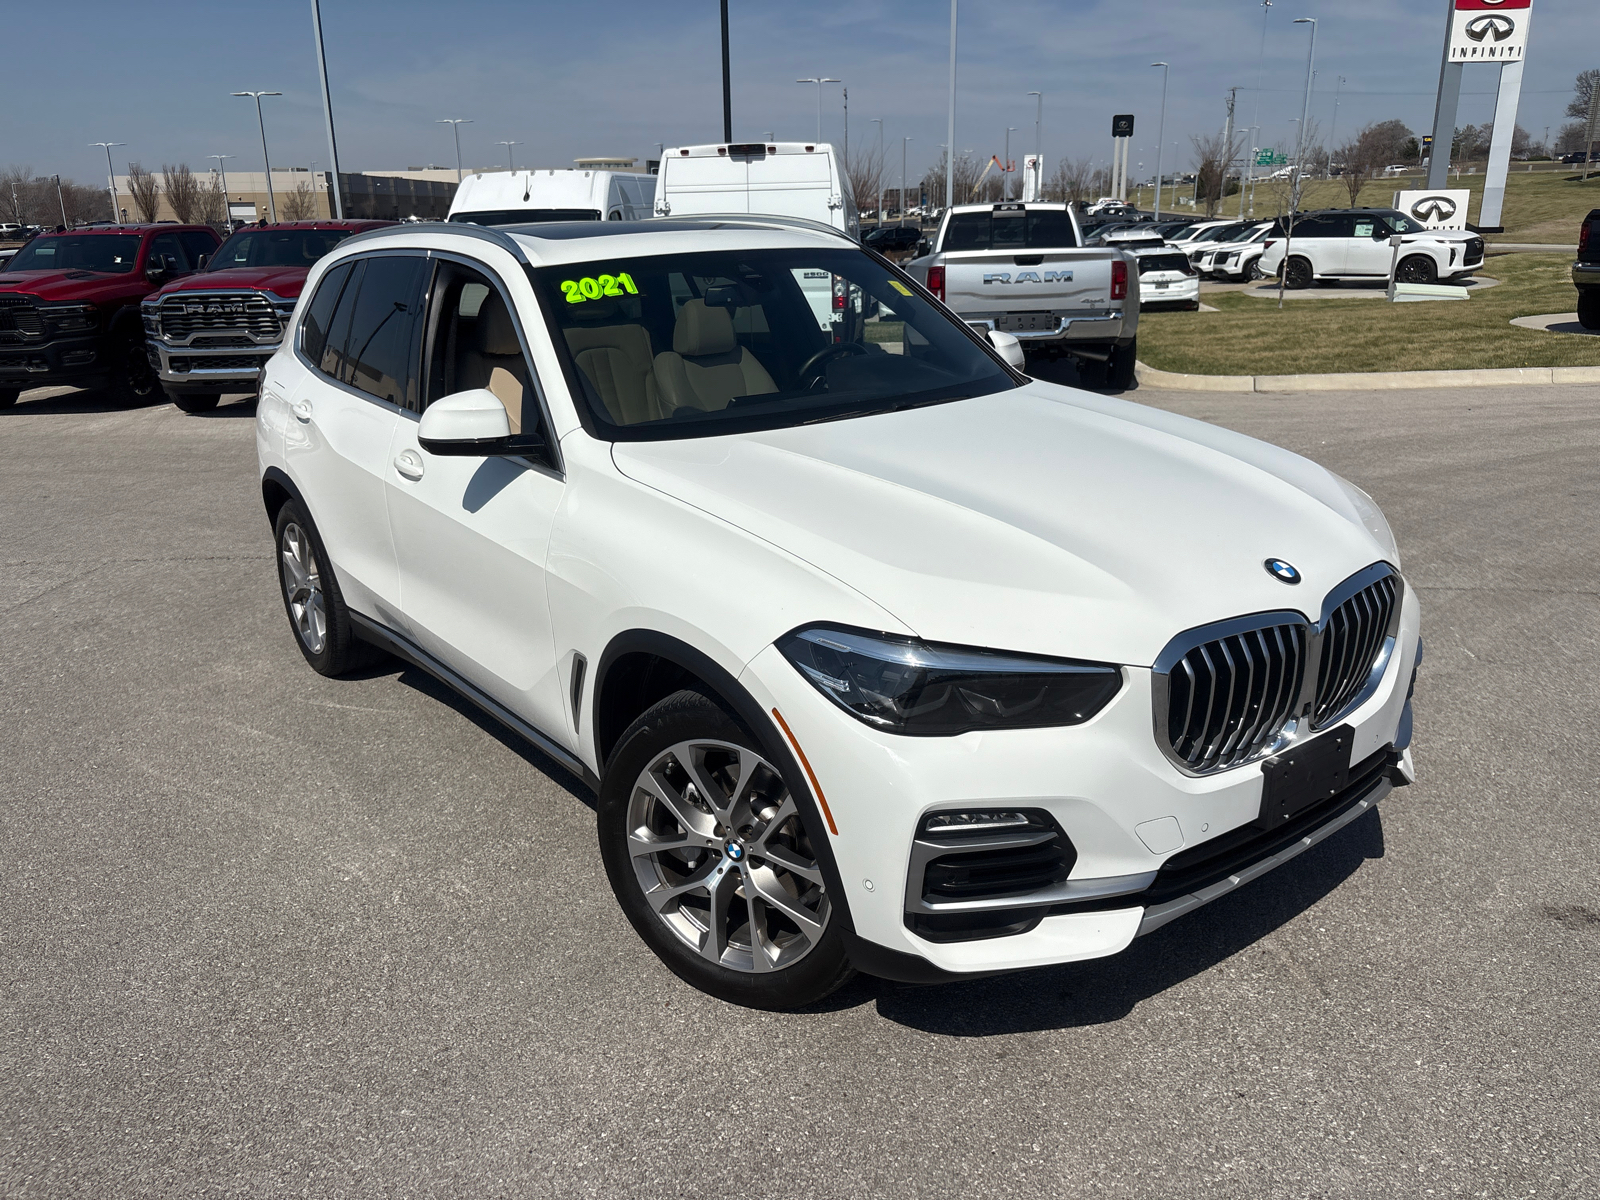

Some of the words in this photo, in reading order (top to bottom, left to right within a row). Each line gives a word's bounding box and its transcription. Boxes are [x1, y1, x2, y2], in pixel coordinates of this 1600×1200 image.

[1452, 46, 1522, 58] INFINITI
[983, 270, 1074, 285] RAM
[560, 272, 639, 304] 2021
[186, 303, 244, 314] RAM
